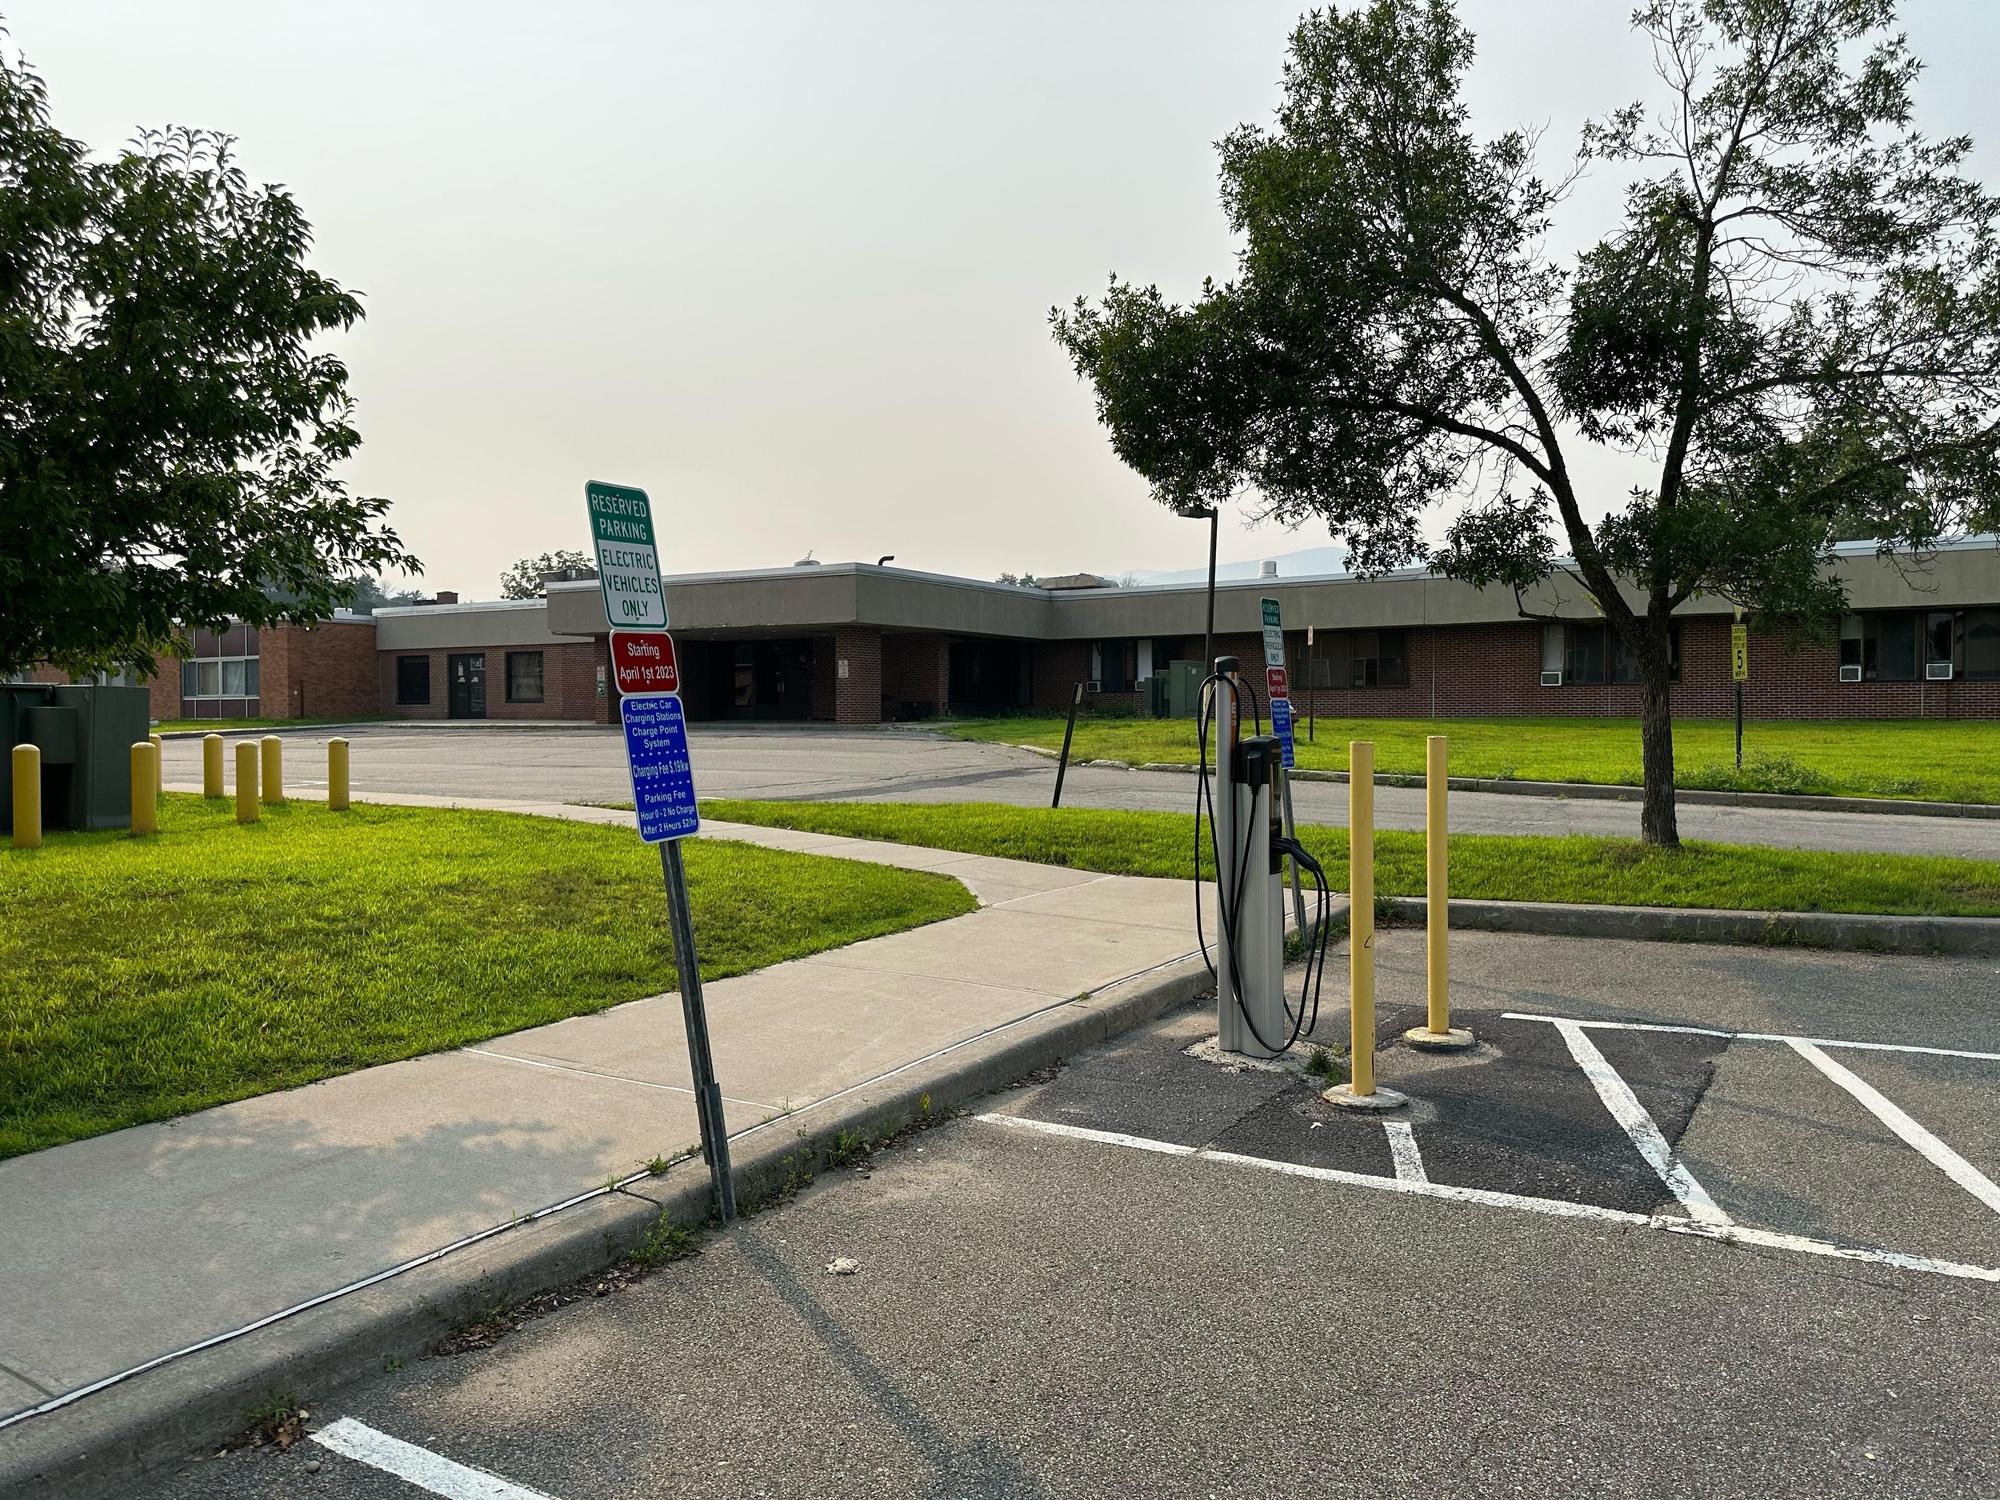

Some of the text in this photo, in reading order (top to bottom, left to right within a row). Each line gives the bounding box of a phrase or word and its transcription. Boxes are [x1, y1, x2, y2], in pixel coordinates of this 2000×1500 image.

[591, 493, 647, 518] RESERVED
[600, 518, 647, 540] PARKING
[602, 549, 654, 570] ELECTRIC
[605, 574, 659, 594] VEHICLES
[622, 600, 649, 617] ONLY
[627, 642, 660, 660] Starting
[1737, 649, 1743, 670] 5
[620, 666, 640, 683] April
[641, 666, 654, 679] 1st
[655, 665, 674, 679] 2023
[631, 700, 672, 711] Electric Car
[625, 712, 681, 724] Charging Stations
[632, 725, 678, 737] Charge Point
[643, 739, 670, 750] System
[633, 764, 658, 780] Charging
[658, 762, 669, 774] Fee
[644, 790, 686, 804] Parking Fee
[640, 811, 655, 821] Hour
[654, 809, 659, 819] 0
[667, 807, 676, 816] No
[676, 805, 695, 815] Charge
[643, 825, 657, 836] After
[663, 822, 682, 831] Hours
